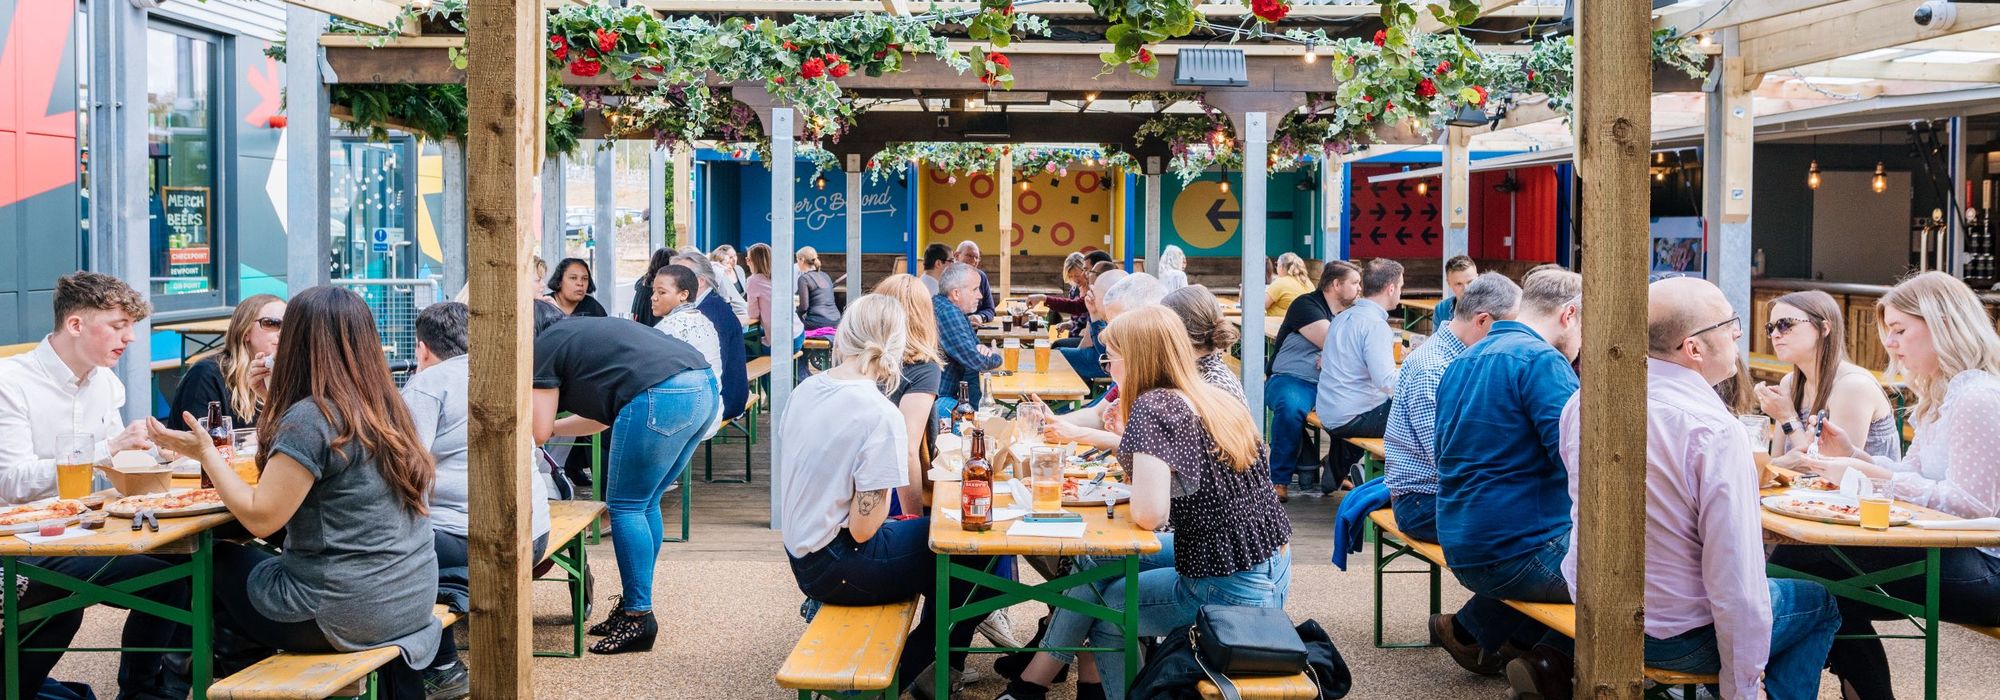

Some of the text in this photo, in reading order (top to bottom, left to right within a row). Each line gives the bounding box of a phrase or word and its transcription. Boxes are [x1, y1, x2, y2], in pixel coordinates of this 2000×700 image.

[168, 194, 204, 208] MERCH
[807, 196, 835, 230] &
[830, 185, 891, 211] Bond
[167, 213, 203, 226] BEERS
